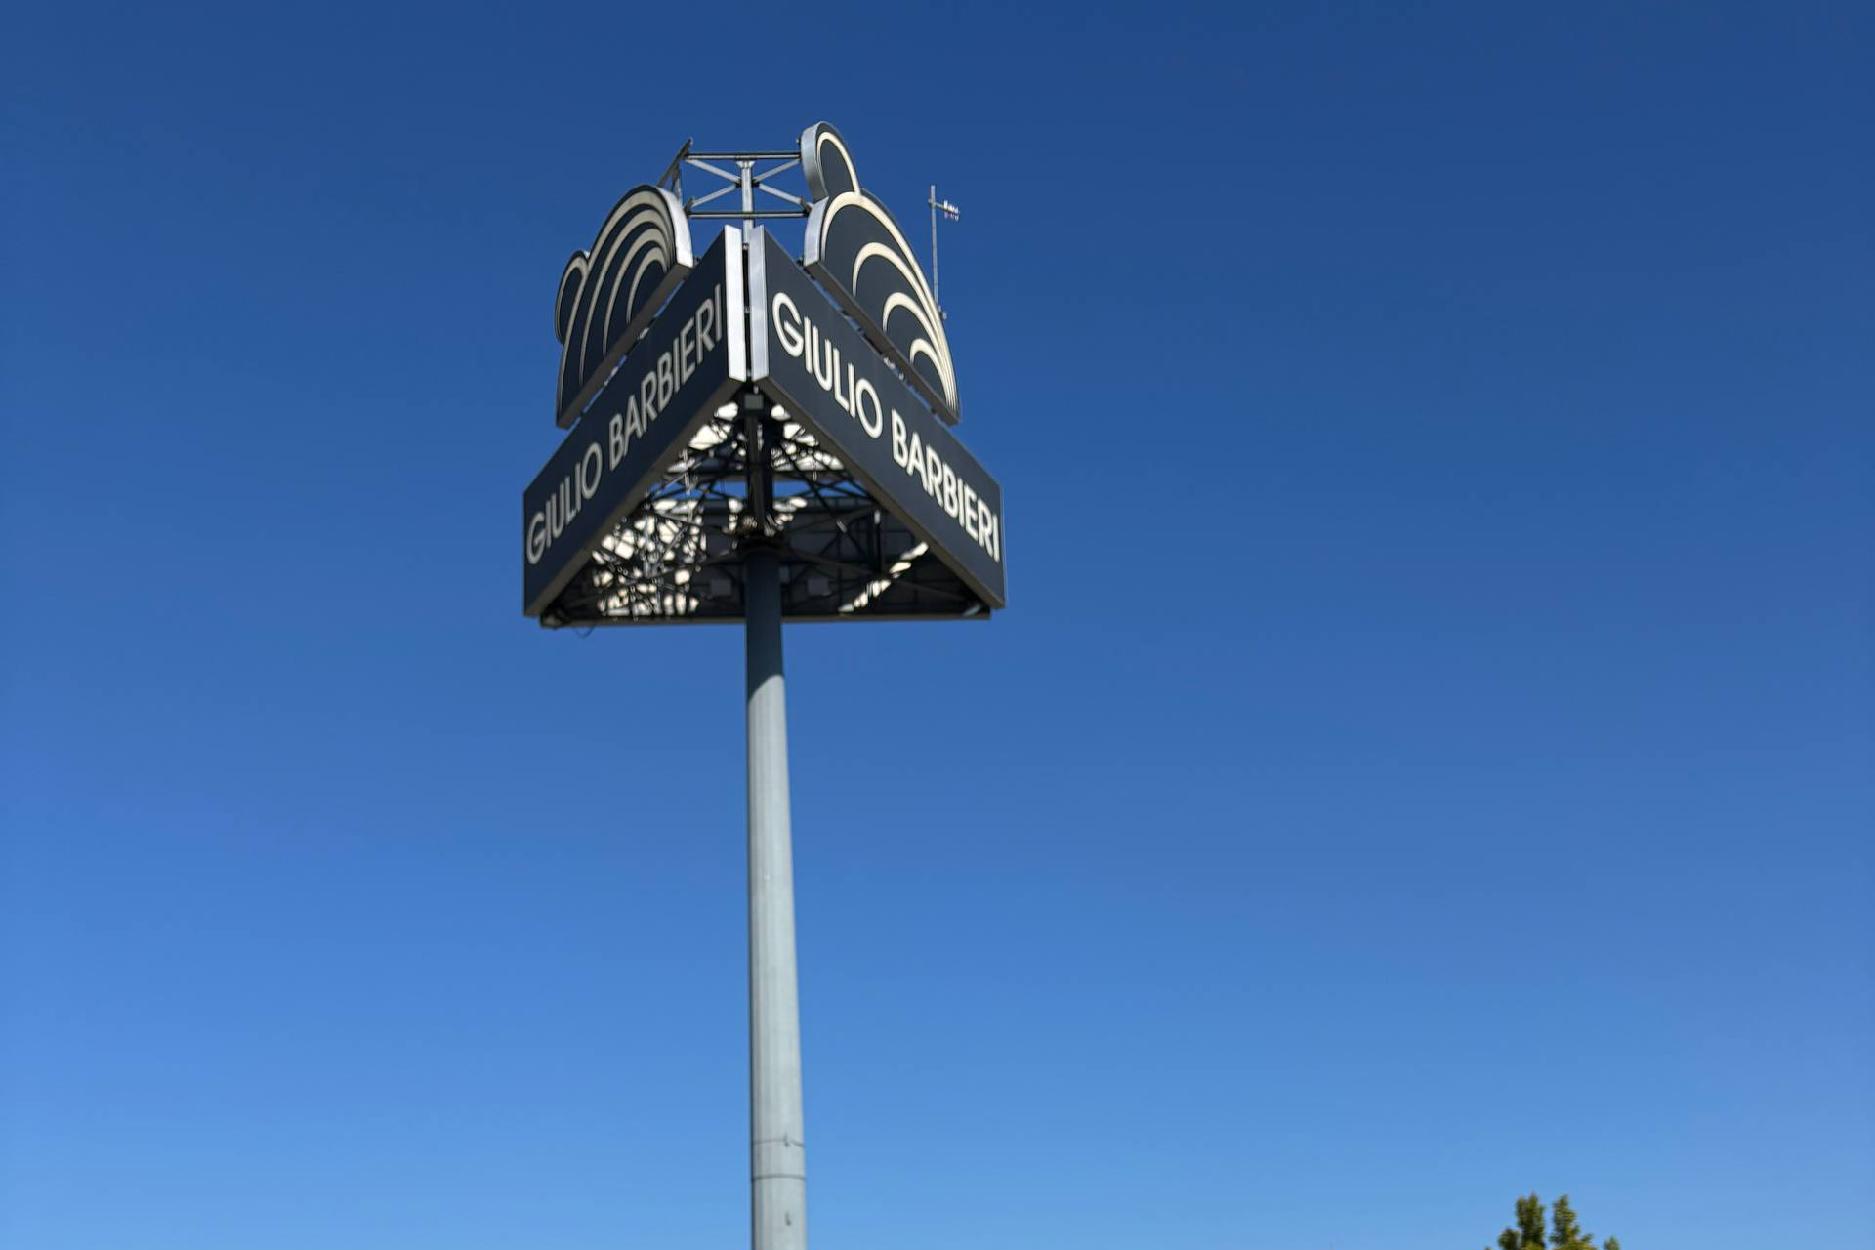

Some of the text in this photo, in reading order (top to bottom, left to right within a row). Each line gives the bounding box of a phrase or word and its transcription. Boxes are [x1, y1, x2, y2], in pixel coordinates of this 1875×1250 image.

[526, 284, 723, 564] GIULIO BARBIERI
[772, 292, 1000, 562] GIULIO BARBIERI
